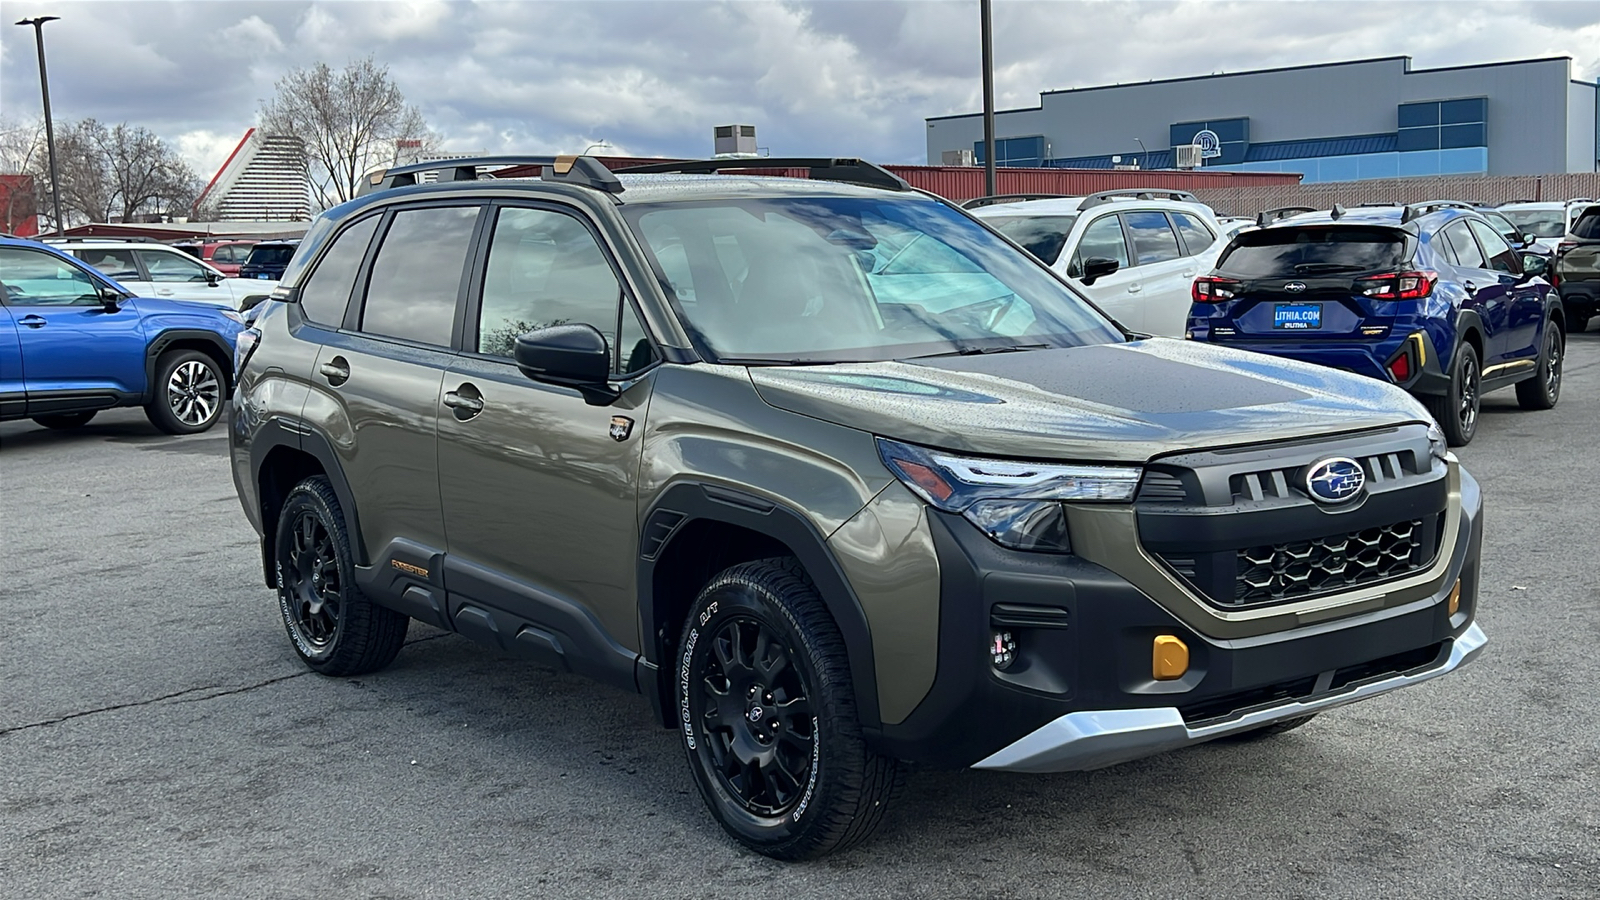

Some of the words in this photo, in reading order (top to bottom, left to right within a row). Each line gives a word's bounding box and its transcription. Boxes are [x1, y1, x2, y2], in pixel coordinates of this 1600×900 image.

[1275, 311, 1320, 321] LITHIA.COM
[391, 559, 429, 578] FORESTER
[681, 628, 699, 750] GEOLANDAR
[700, 601, 719, 627] A/T
